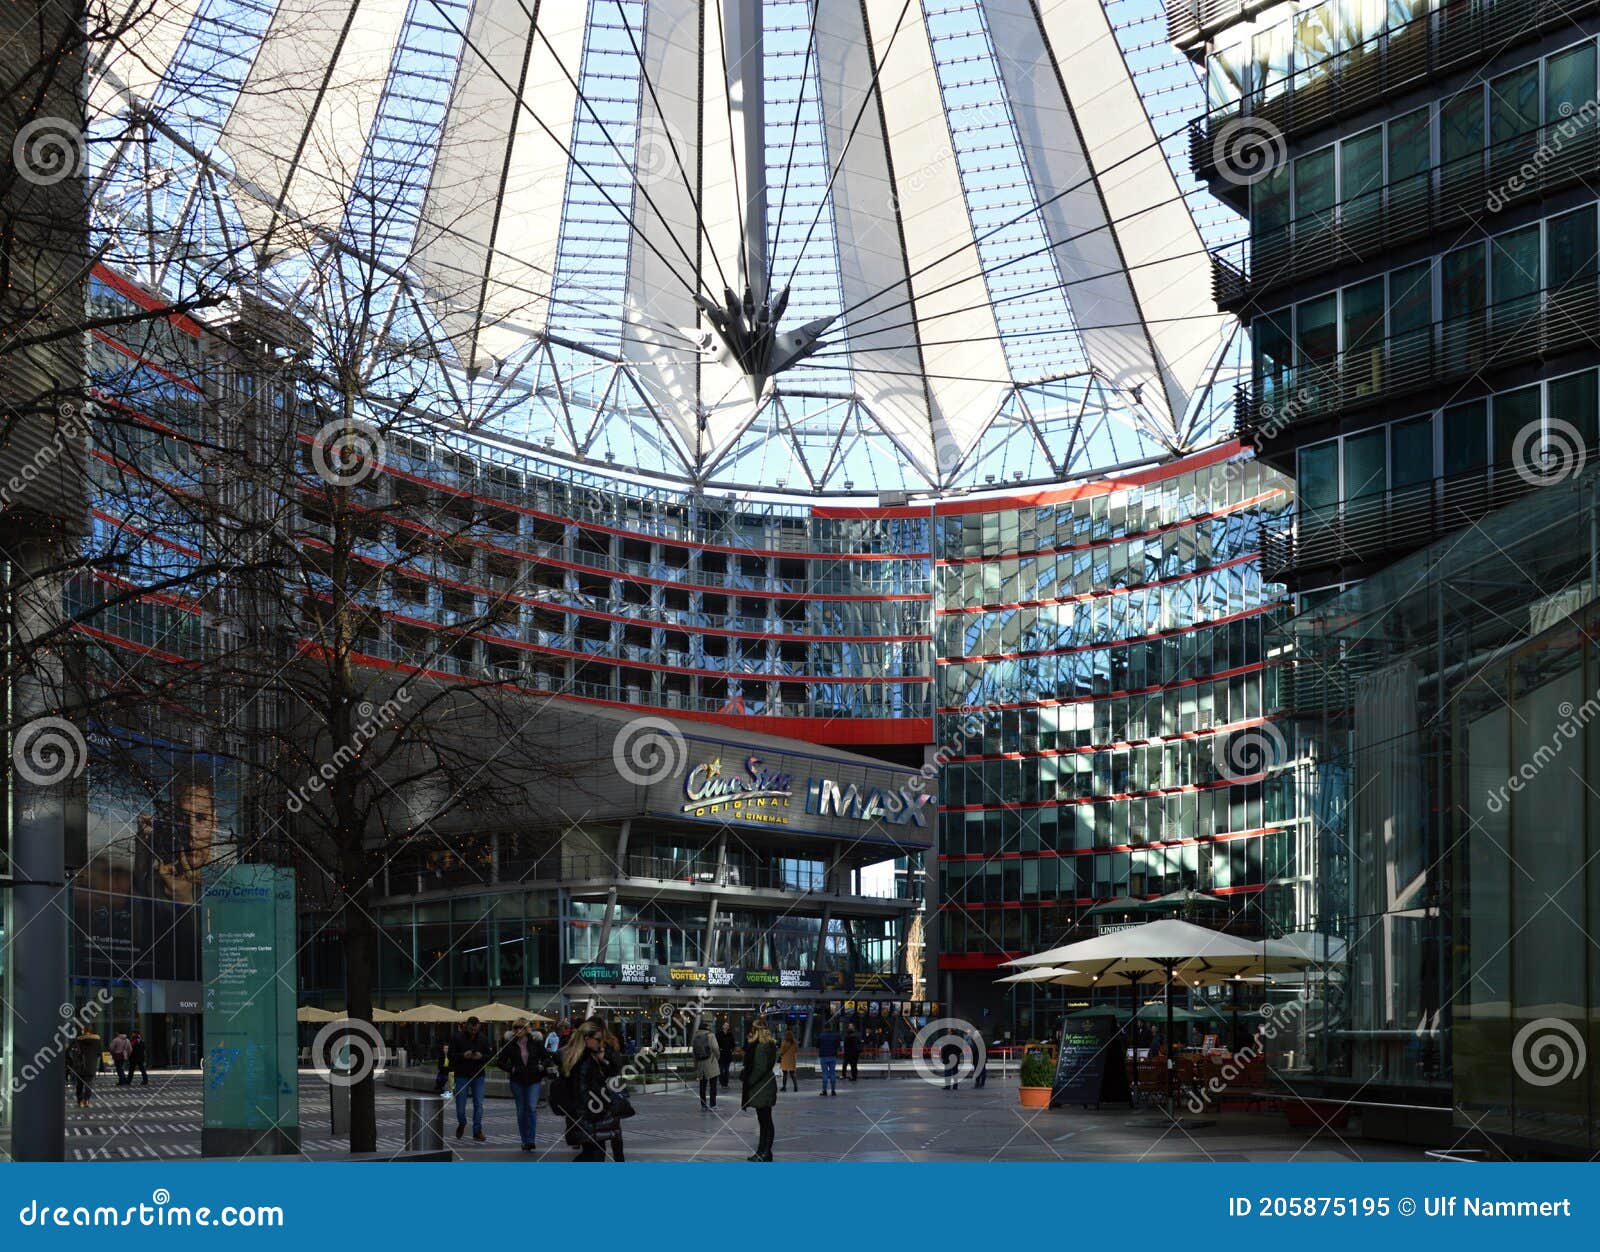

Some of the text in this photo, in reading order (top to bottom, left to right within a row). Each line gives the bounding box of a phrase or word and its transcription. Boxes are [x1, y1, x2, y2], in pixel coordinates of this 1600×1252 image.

[695, 798, 791, 817] ORIGINAL
[805, 777, 931, 828] IMAX
[745, 812, 788, 824] CINEMAS
[204, 886, 231, 898] Sony
[232, 885, 271, 897] Center
